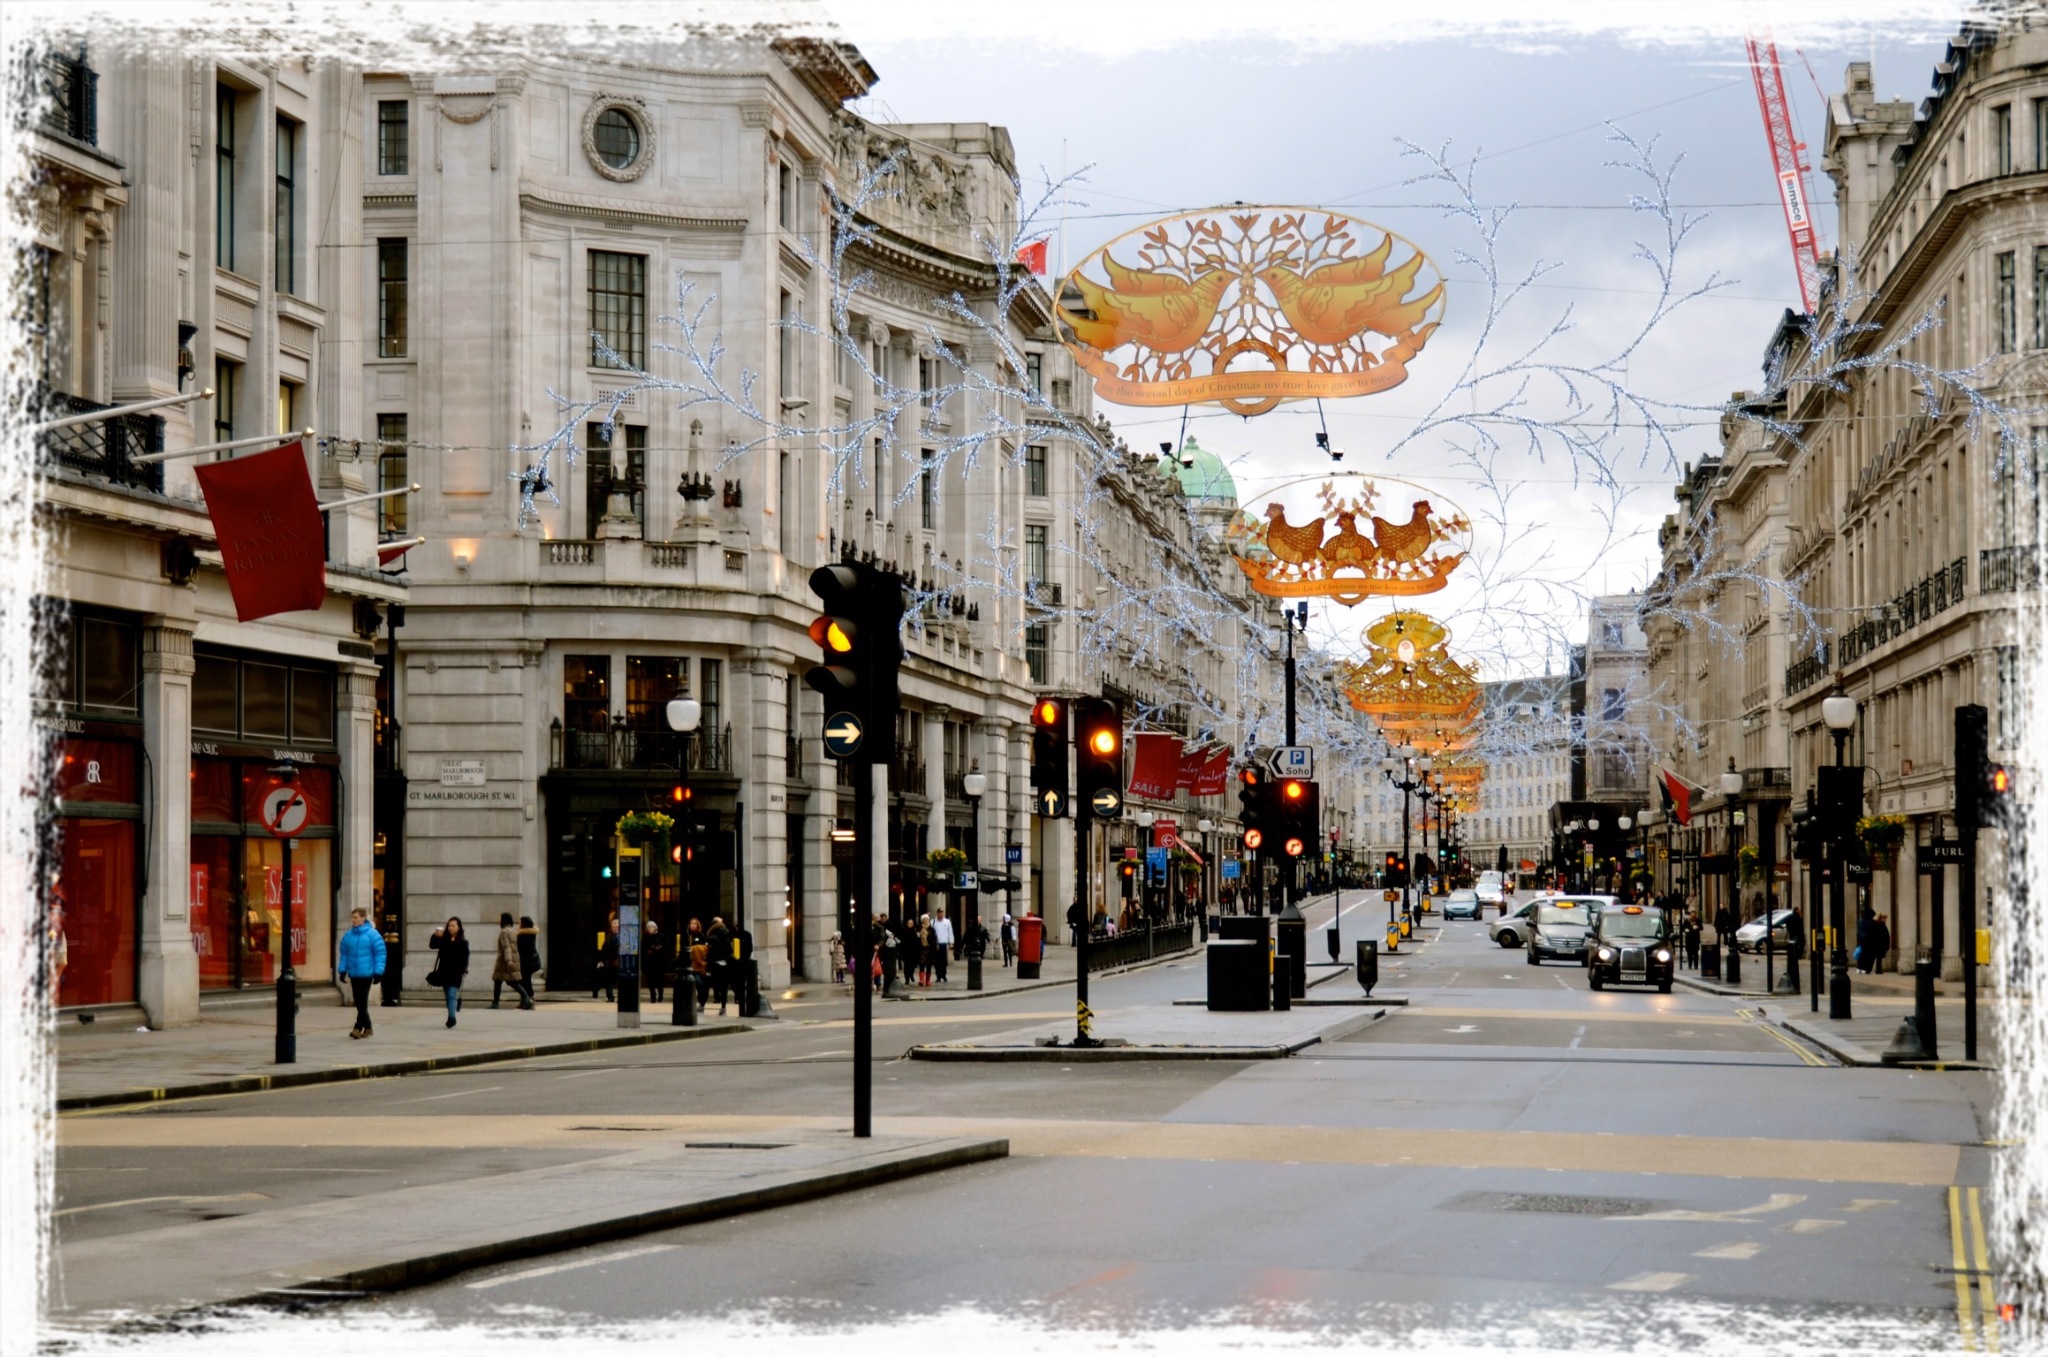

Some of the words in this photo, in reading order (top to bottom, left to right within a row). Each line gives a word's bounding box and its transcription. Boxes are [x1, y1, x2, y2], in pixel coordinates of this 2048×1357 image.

[1788, 190, 1802, 221] mace
[1116, 384, 1134, 397] the
[1136, 387, 1171, 398] second
[1175, 386, 1193, 397] day
[1196, 382, 1206, 394] of
[1208, 380, 1260, 392] Christmas
[1264, 383, 1279, 392] my
[1283, 380, 1304, 390] true
[1307, 379, 1328, 390] love
[1331, 381, 1355, 392] gave
[1358, 379, 1368, 387] to
[1323, 583, 1356, 591] Christmas
[1293, 751, 1302, 764] P
[1286, 767, 1309, 775] Soho
[1133, 781, 1161, 796] SALE
[424, 792, 489, 800] MARLBOROUGH
[1007, 850, 1020, 859] GAP
